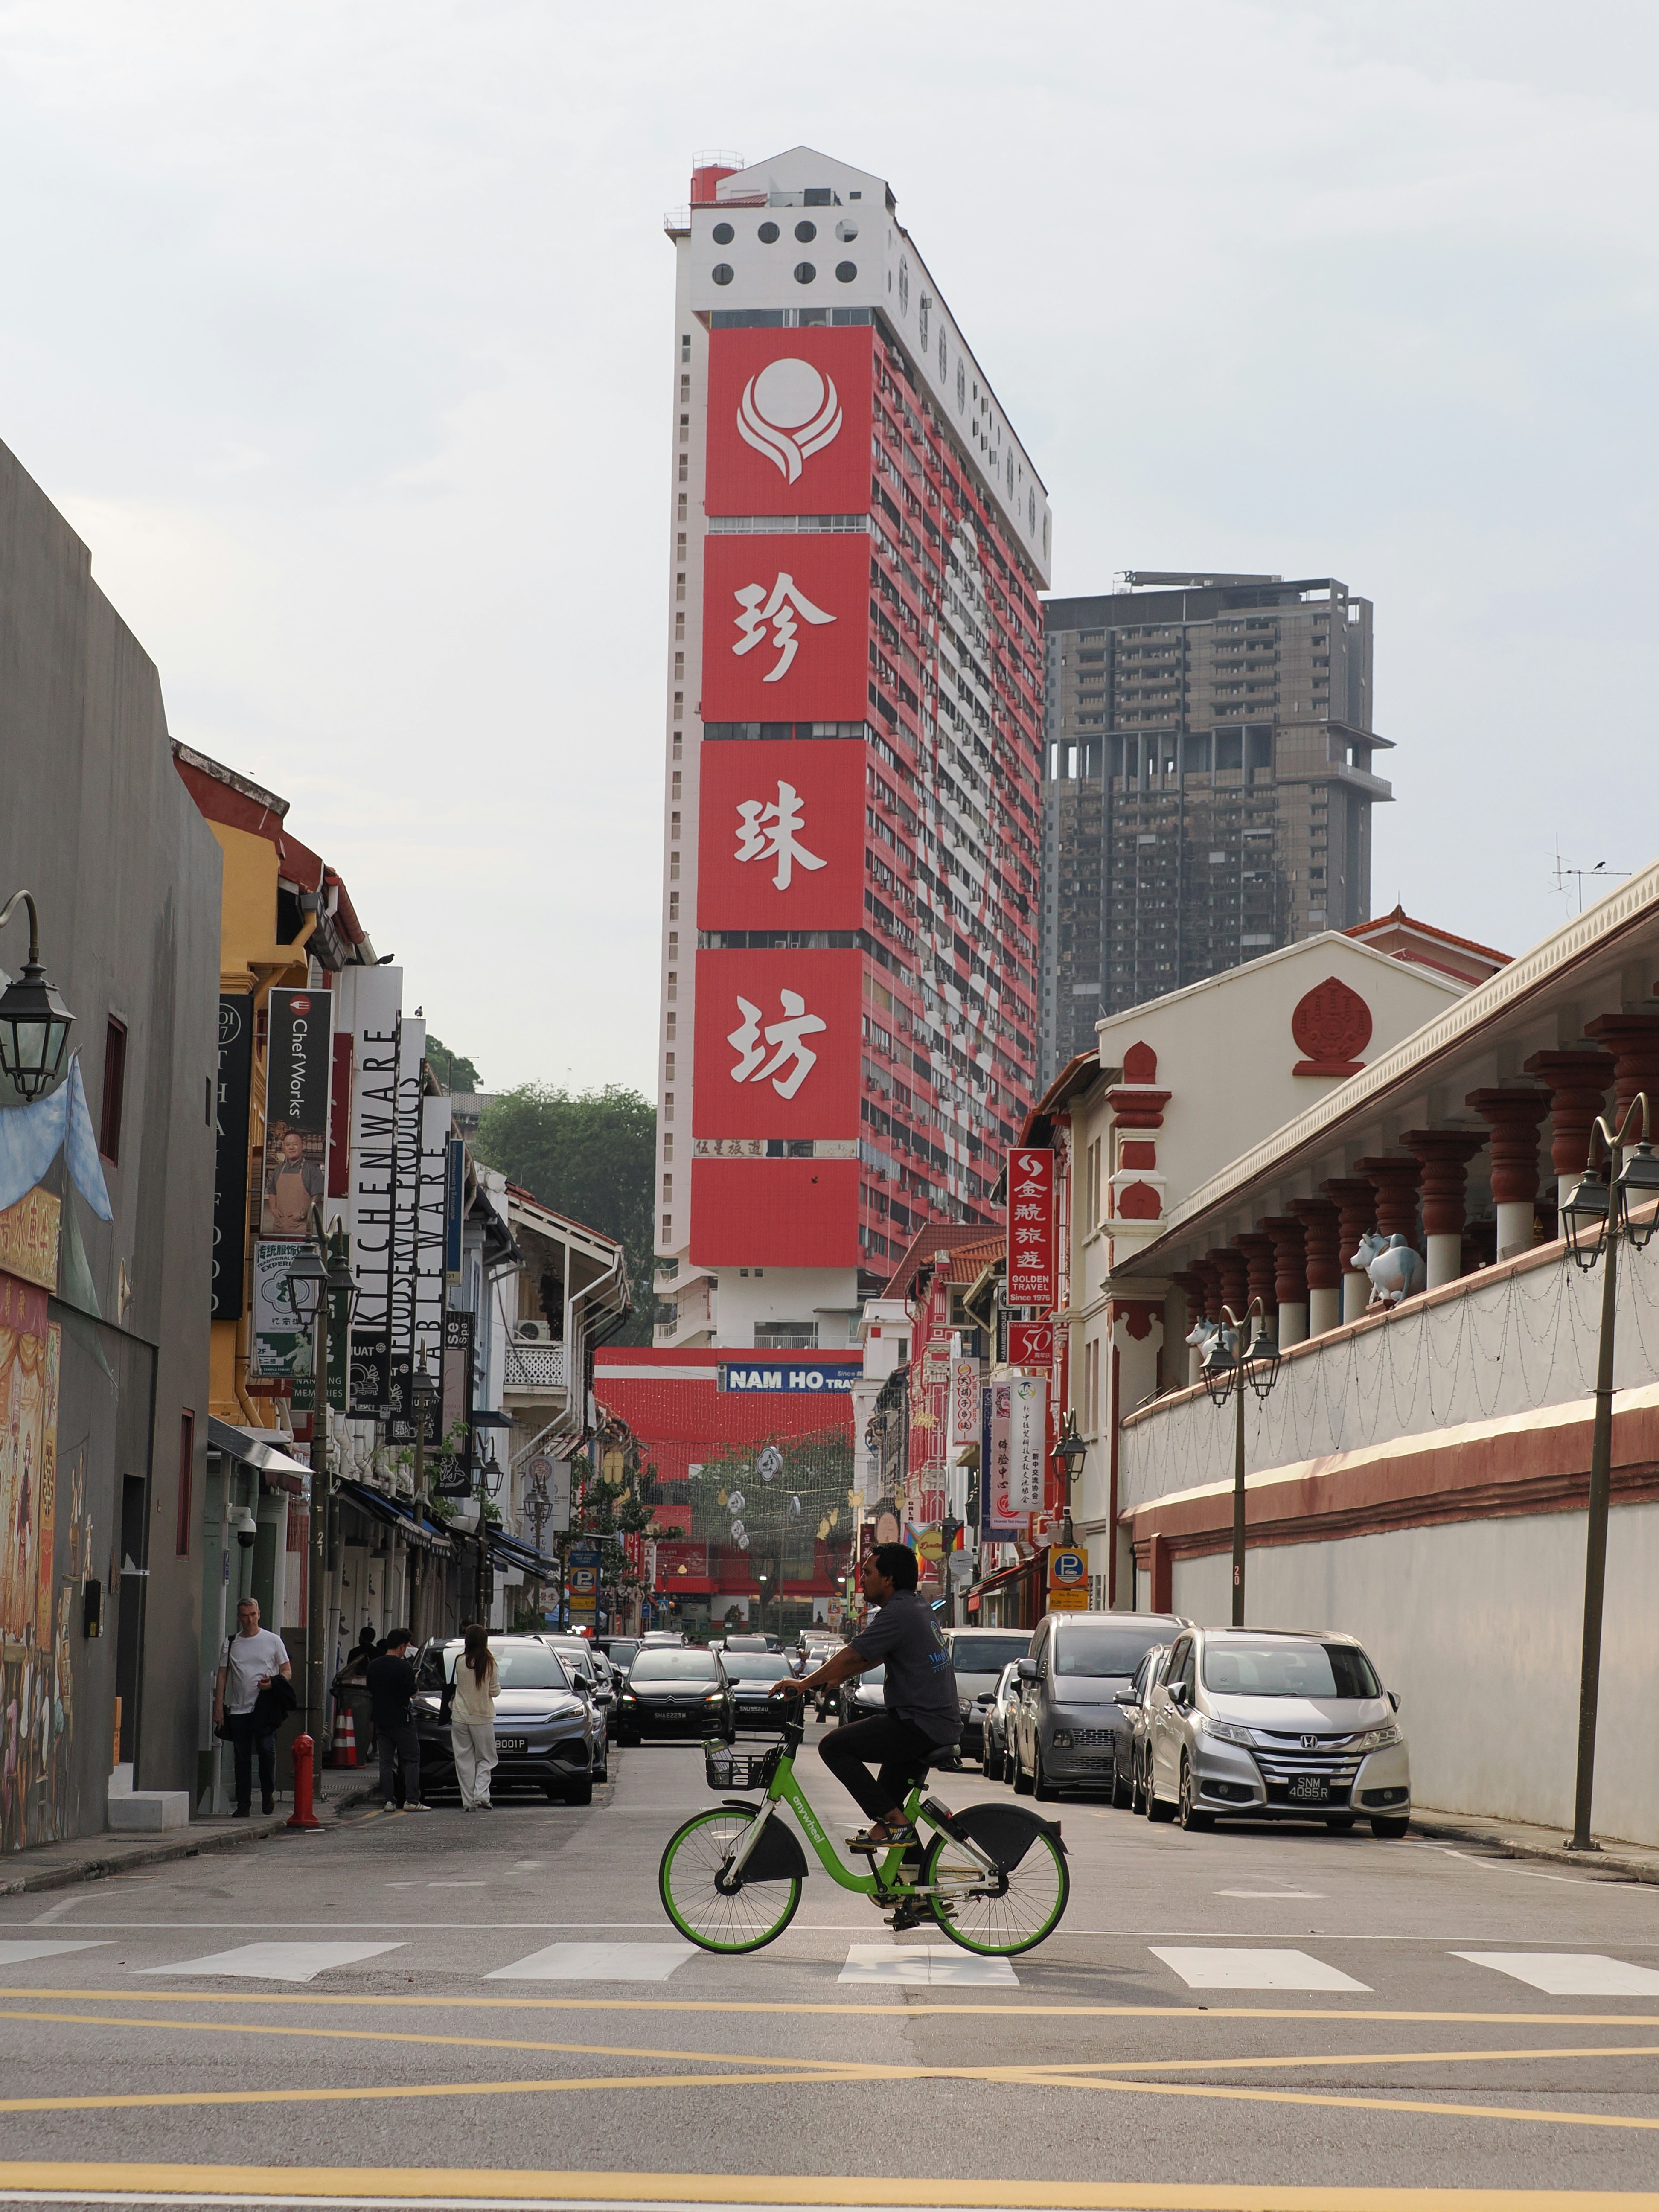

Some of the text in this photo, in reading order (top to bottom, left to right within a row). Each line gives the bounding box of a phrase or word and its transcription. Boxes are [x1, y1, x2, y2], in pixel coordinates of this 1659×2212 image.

[727, 572, 838, 1100] 珍珠坊
[289, 1019, 308, 1117] Chef Works
[355, 1030, 397, 1326] KITCHENWARE
[391, 1077, 420, 1349] FOODSERVICE PRODUCTS
[257, 1256, 290, 1268] TRADITIONAL
[1013, 1283, 1049, 1291] TRAVEL
[459, 1323, 469, 1344] Spa
[1010, 1324, 1051, 1365] 50
[730, 1371, 782, 1389] NAM
[789, 1371, 824, 1389] HO
[1234, 1566, 1240, 1585] 20
[1298, 1777, 1320, 1787] SNM
[793, 1796, 825, 1843] anywheel
